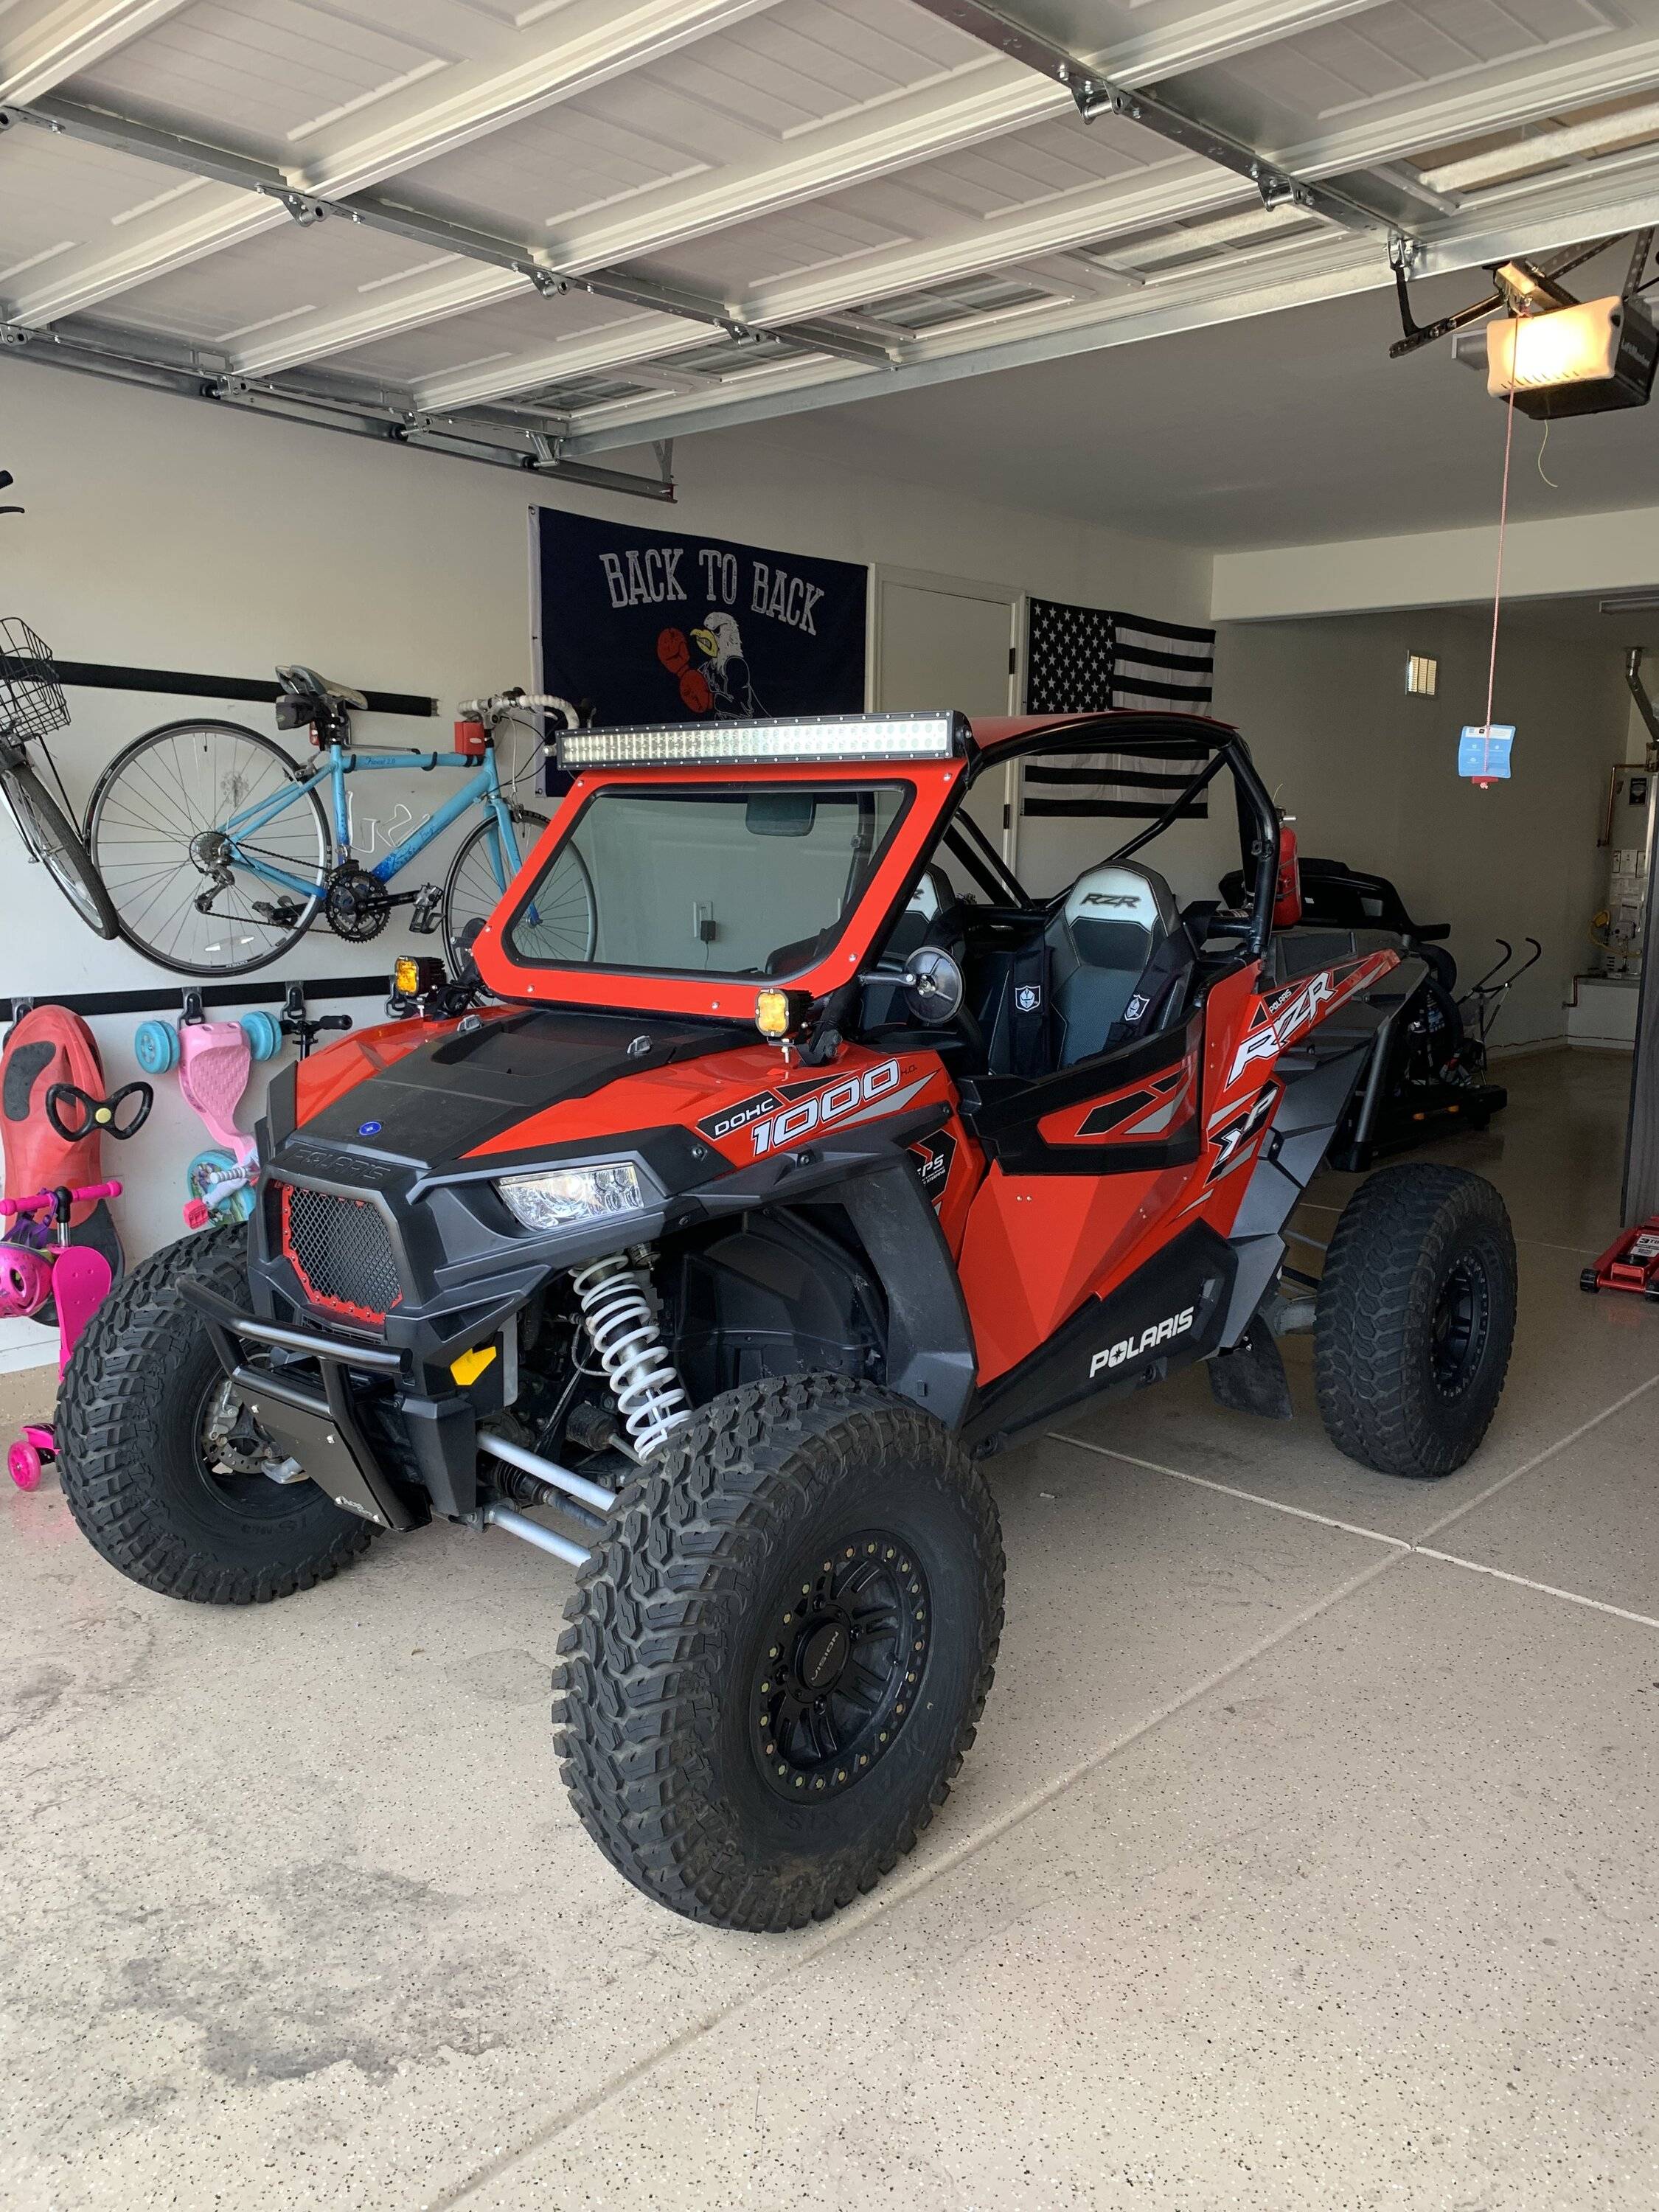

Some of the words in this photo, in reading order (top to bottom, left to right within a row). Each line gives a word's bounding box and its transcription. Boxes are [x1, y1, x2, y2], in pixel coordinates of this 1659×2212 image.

[599, 548, 687, 608] BACK
[698, 549, 738, 605] TO
[751, 560, 825, 636] BACK
[1079, 892, 1142, 908] RZR
[1226, 972, 1337, 1089] RZR
[1269, 989, 1293, 1014] POLARIS
[714, 1098, 774, 1137] DOHC
[752, 1058, 900, 1157] 1000
[285, 1149, 391, 1180] POLARIS
[1089, 1306, 1194, 1378] POLARIS
[811, 1631, 839, 1681] VISION
